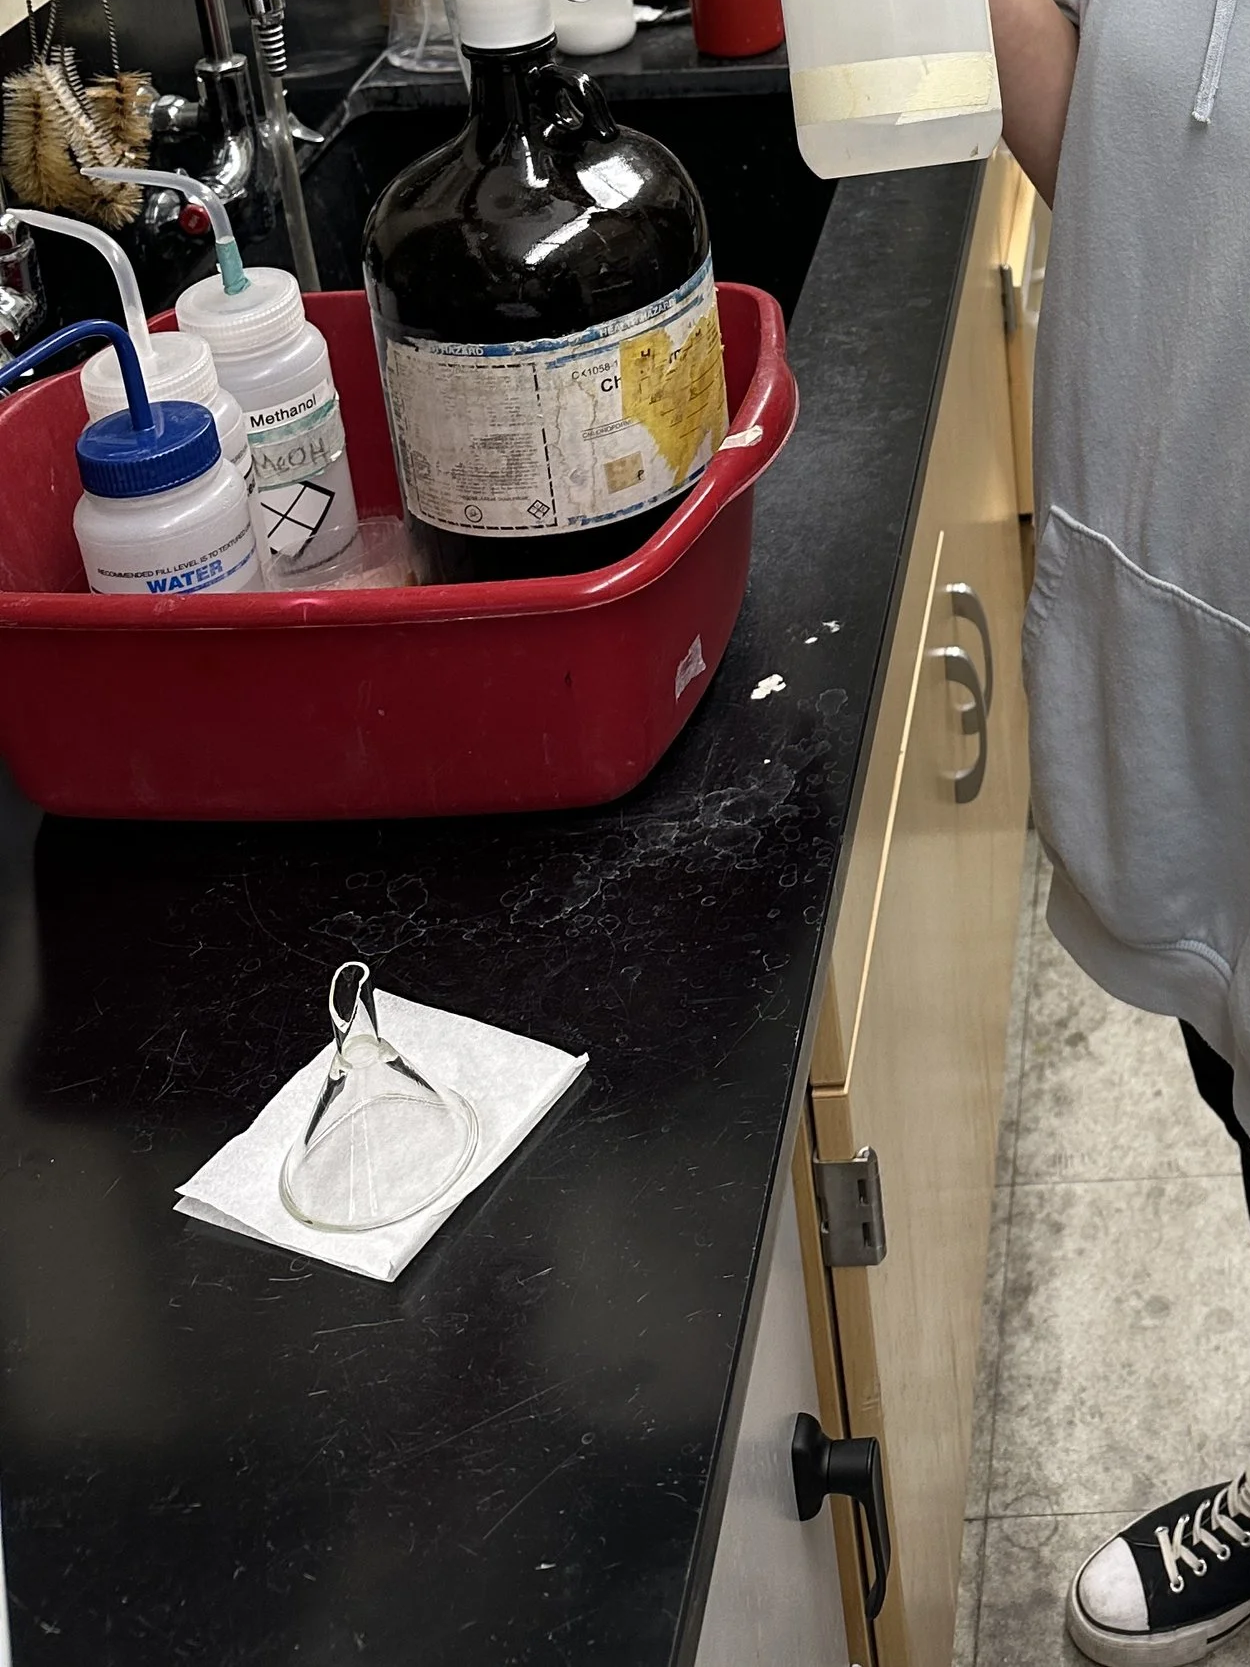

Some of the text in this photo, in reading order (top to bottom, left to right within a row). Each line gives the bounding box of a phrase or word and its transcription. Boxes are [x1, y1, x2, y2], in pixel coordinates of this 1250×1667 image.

[250, 393, 317, 428] Methanol
[97, 567, 155, 579] RECOMMENDED
[155, 567, 172, 576] FILL
[173, 559, 200, 572] LEVEL
[200, 555, 208, 563] IS
[208, 549, 219, 559] TO
[146, 559, 223, 594] WATER
